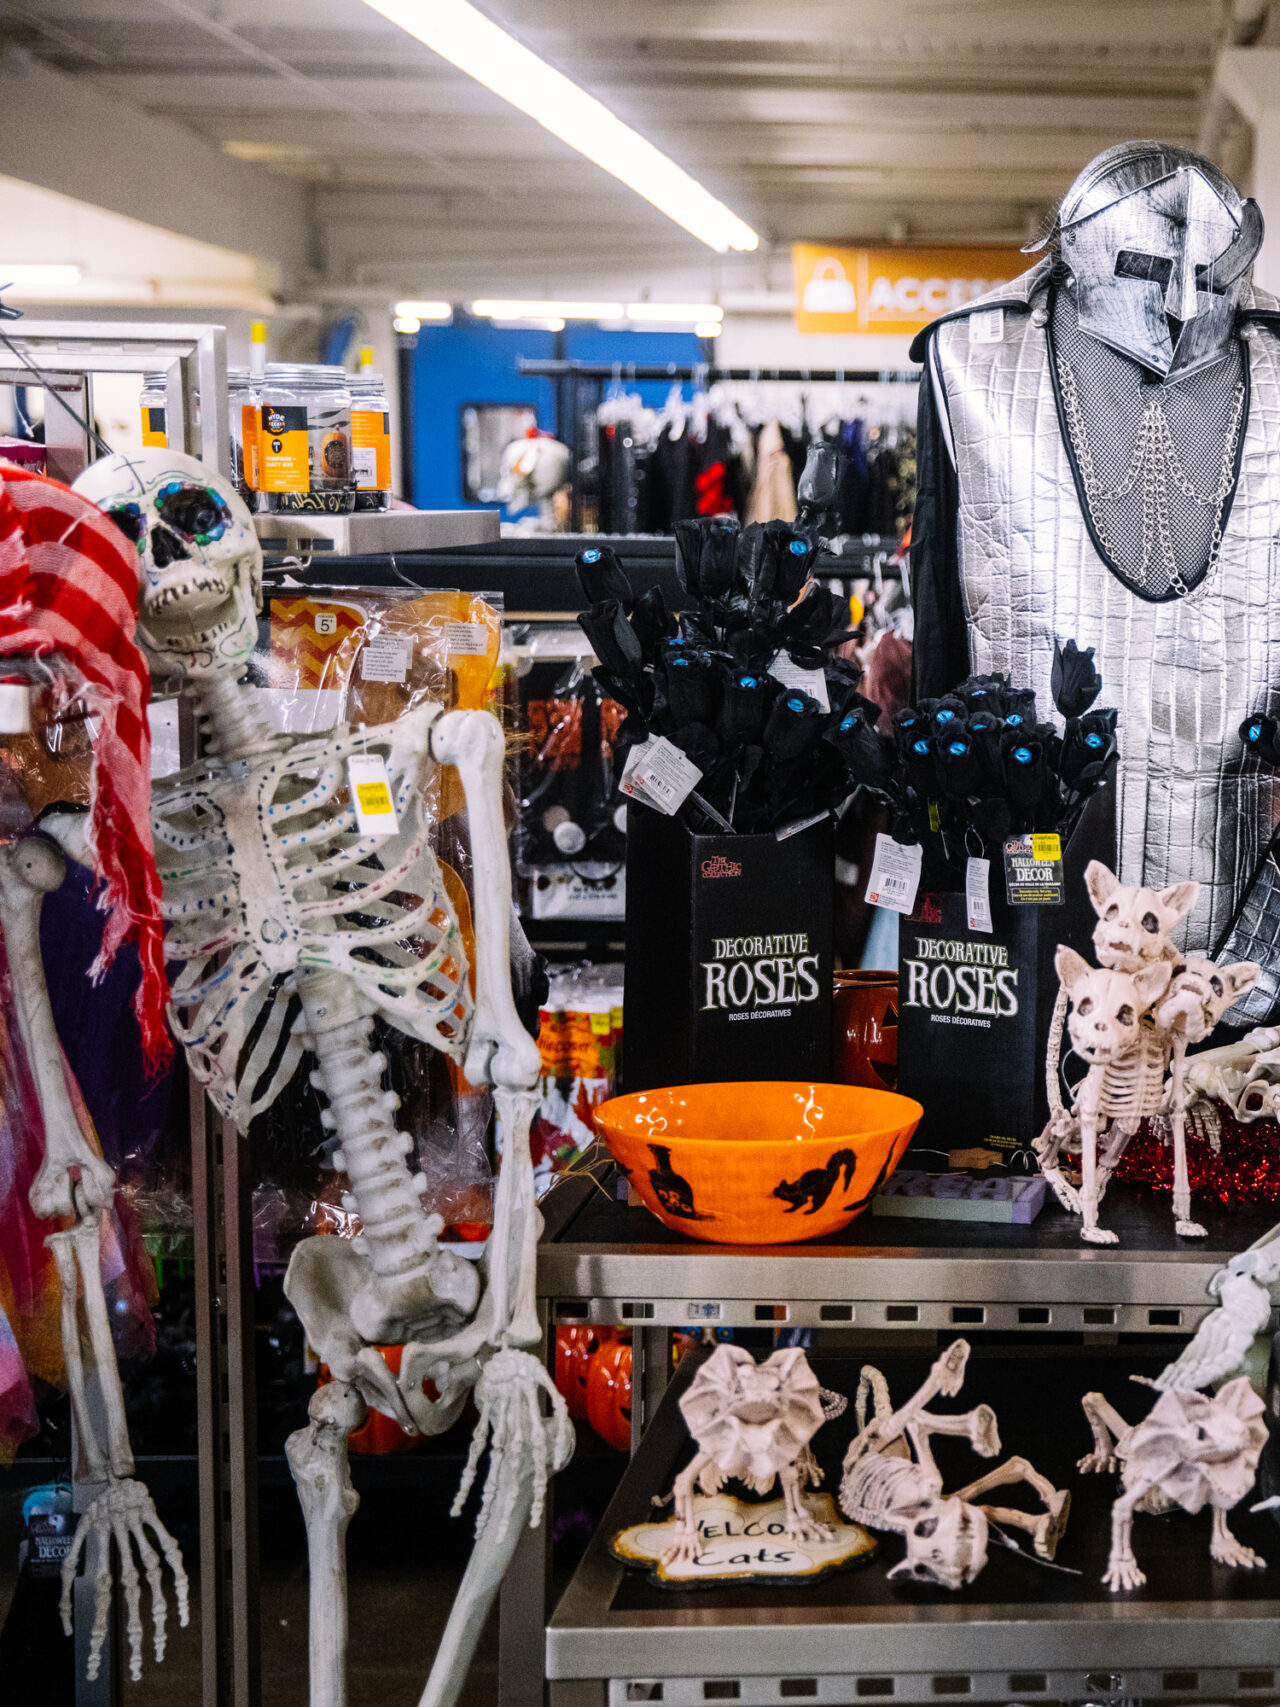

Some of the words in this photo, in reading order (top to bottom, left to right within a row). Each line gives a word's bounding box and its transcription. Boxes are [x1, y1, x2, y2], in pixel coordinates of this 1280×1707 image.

[1015, 867, 1054, 881] DECOR
[713, 933, 809, 959] DECORATIVE
[915, 937, 1009, 967] DECORATIVE
[700, 954, 819, 1010] ROSES
[903, 958, 1019, 1018] ROSES
[728, 1012, 750, 1021] ROSES
[930, 1013, 951, 1023] ROSES
